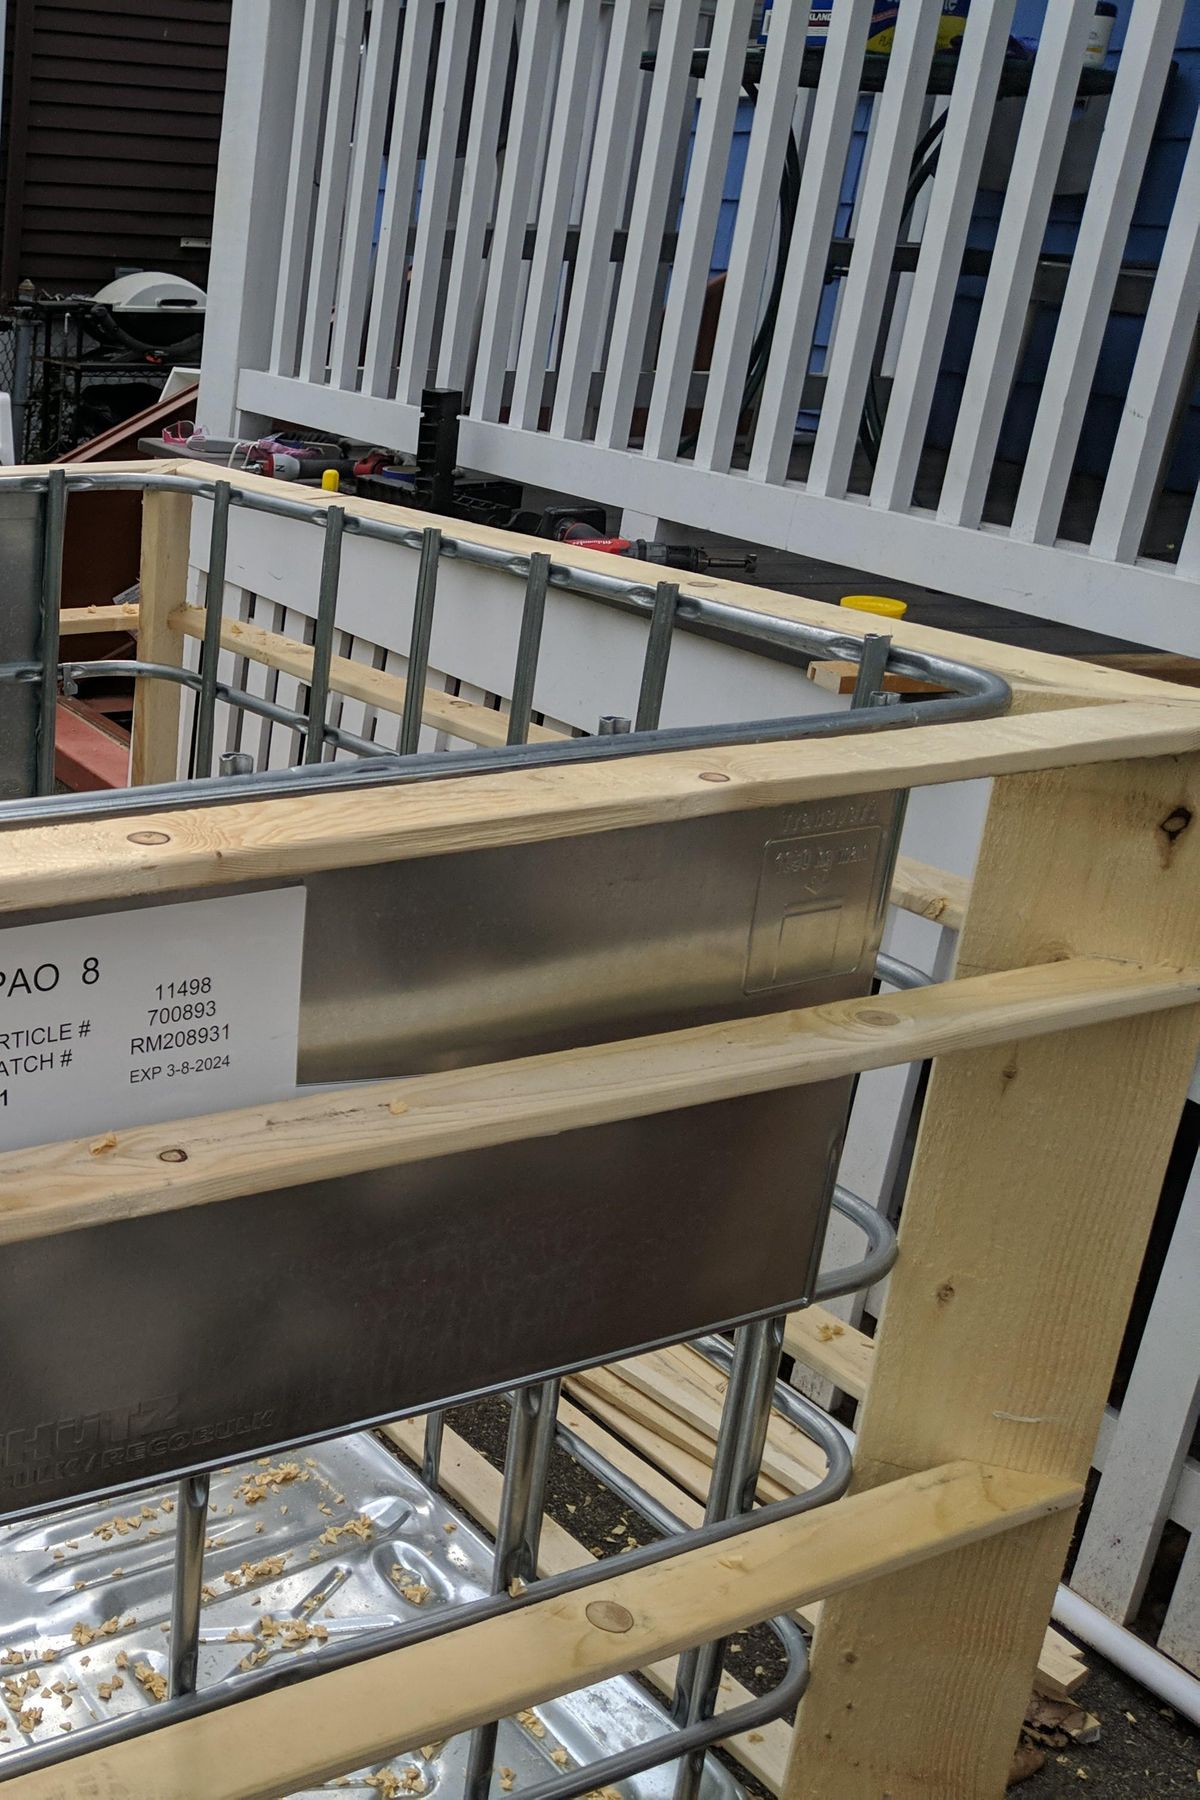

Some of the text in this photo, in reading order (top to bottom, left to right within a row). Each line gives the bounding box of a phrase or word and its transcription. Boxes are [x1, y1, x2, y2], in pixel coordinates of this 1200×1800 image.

[81, 957, 101, 985] 8
[155, 977, 212, 1001] 11498
[147, 1000, 217, 1026] 700893
[130, 1023, 231, 1055] RM208931
[130, 1054, 231, 1084] EXP 3-8-2024
